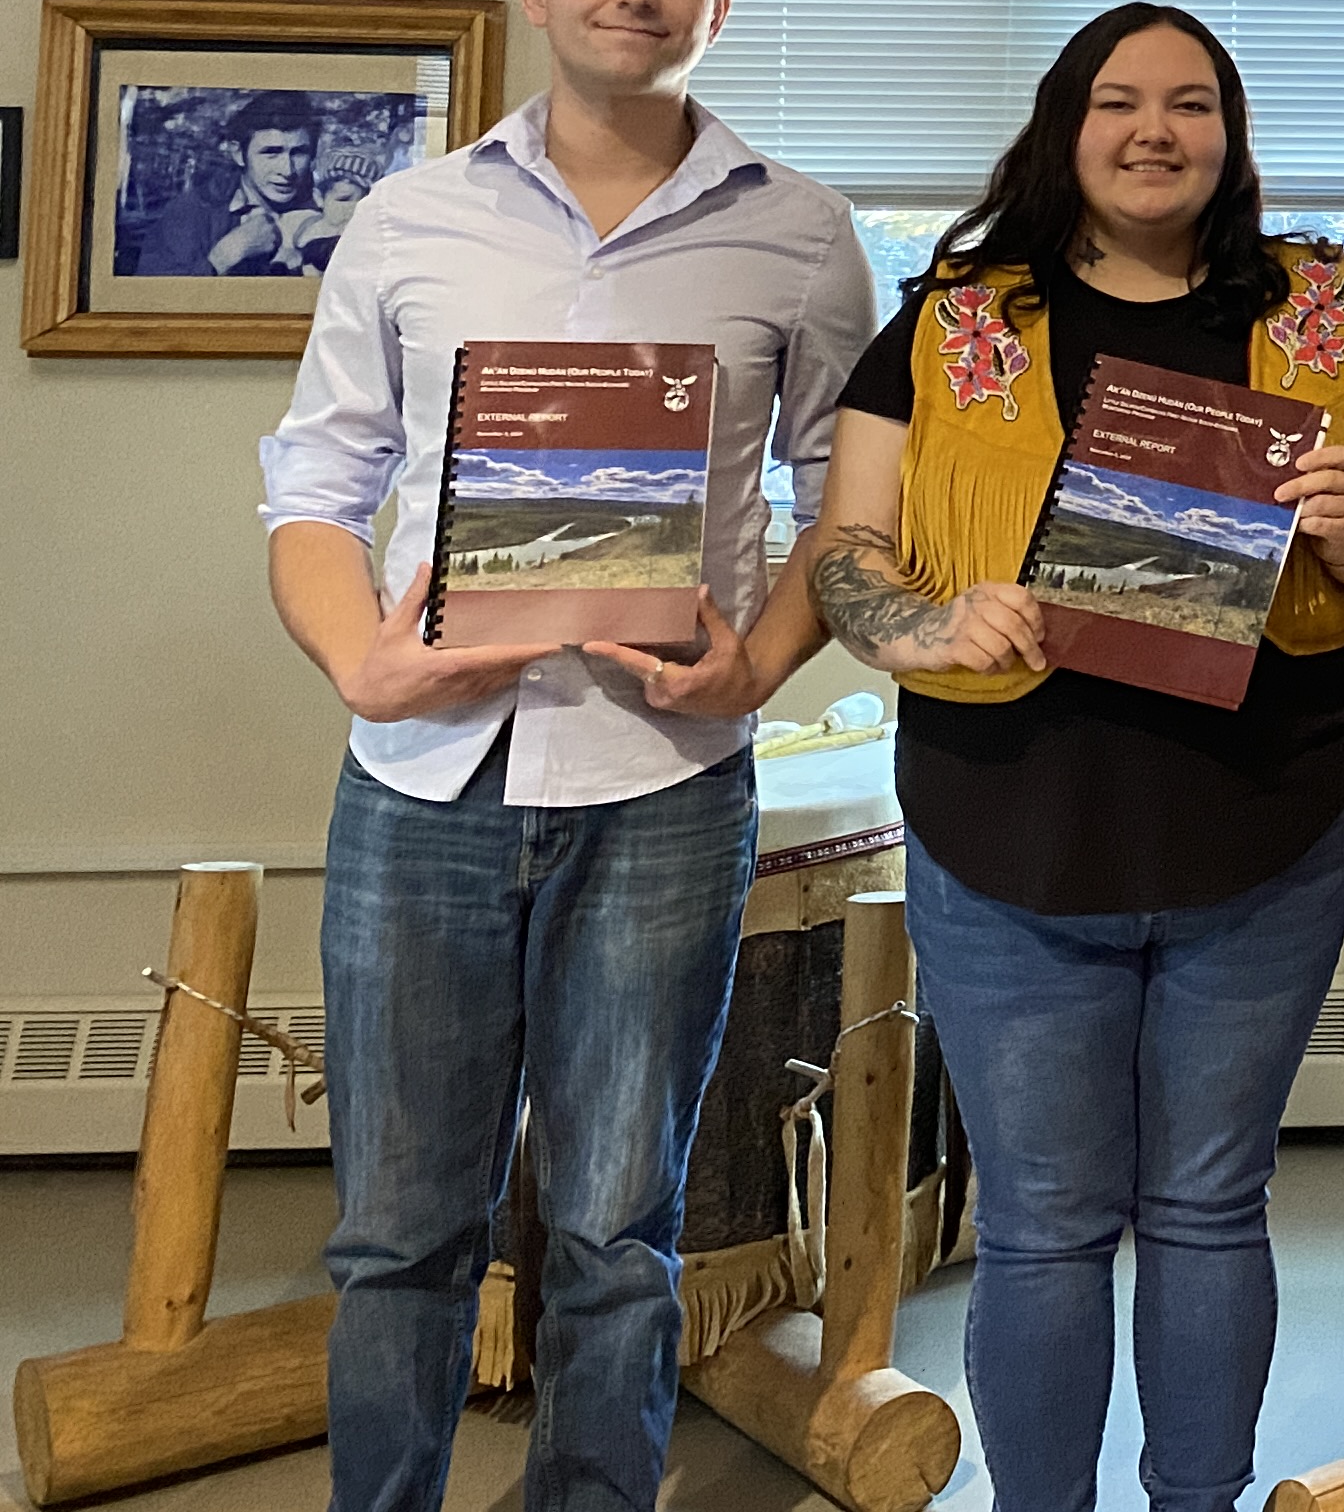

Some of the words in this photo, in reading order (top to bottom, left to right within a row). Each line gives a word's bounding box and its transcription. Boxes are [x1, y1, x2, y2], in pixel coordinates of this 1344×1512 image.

[478, 413, 526, 422] EXTERNAL
[1093, 428, 1138, 449] EXTERNAL
[1139, 439, 1176, 455] REPORT
